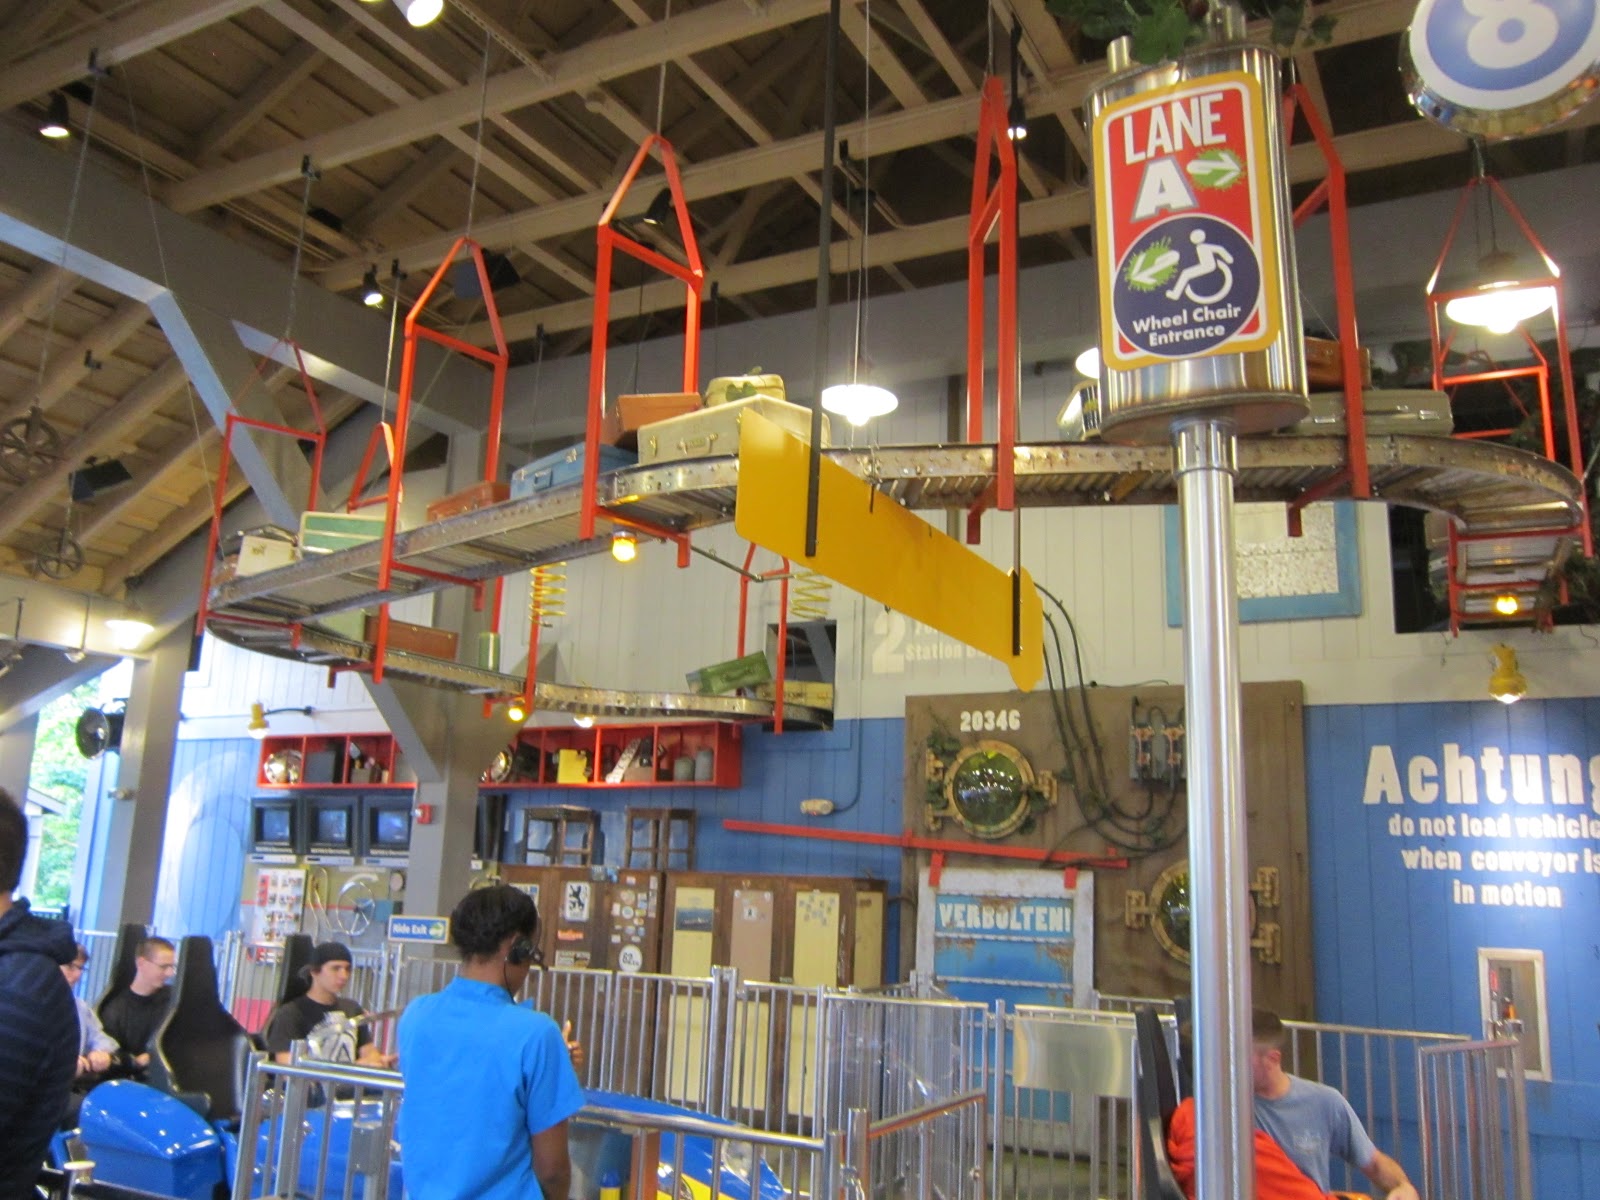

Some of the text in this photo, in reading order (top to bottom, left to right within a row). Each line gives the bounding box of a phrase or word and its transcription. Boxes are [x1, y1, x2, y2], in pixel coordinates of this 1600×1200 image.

[1123, 93, 1227, 165] LANE
[1131, 156, 1199, 221] A
[1132, 303, 1242, 335] Wheel Chair
[1148, 323, 1226, 348] Entrance
[872, 609, 905, 674] 2
[959, 709, 1021, 733] 20346
[1388, 813, 1415, 838] do
[1419, 813, 1456, 838] not
[1461, 812, 1511, 839] load
[1401, 845, 1462, 871] when
[1471, 848, 1579, 878] conveyor
[1452, 879, 1562, 908] in motion
